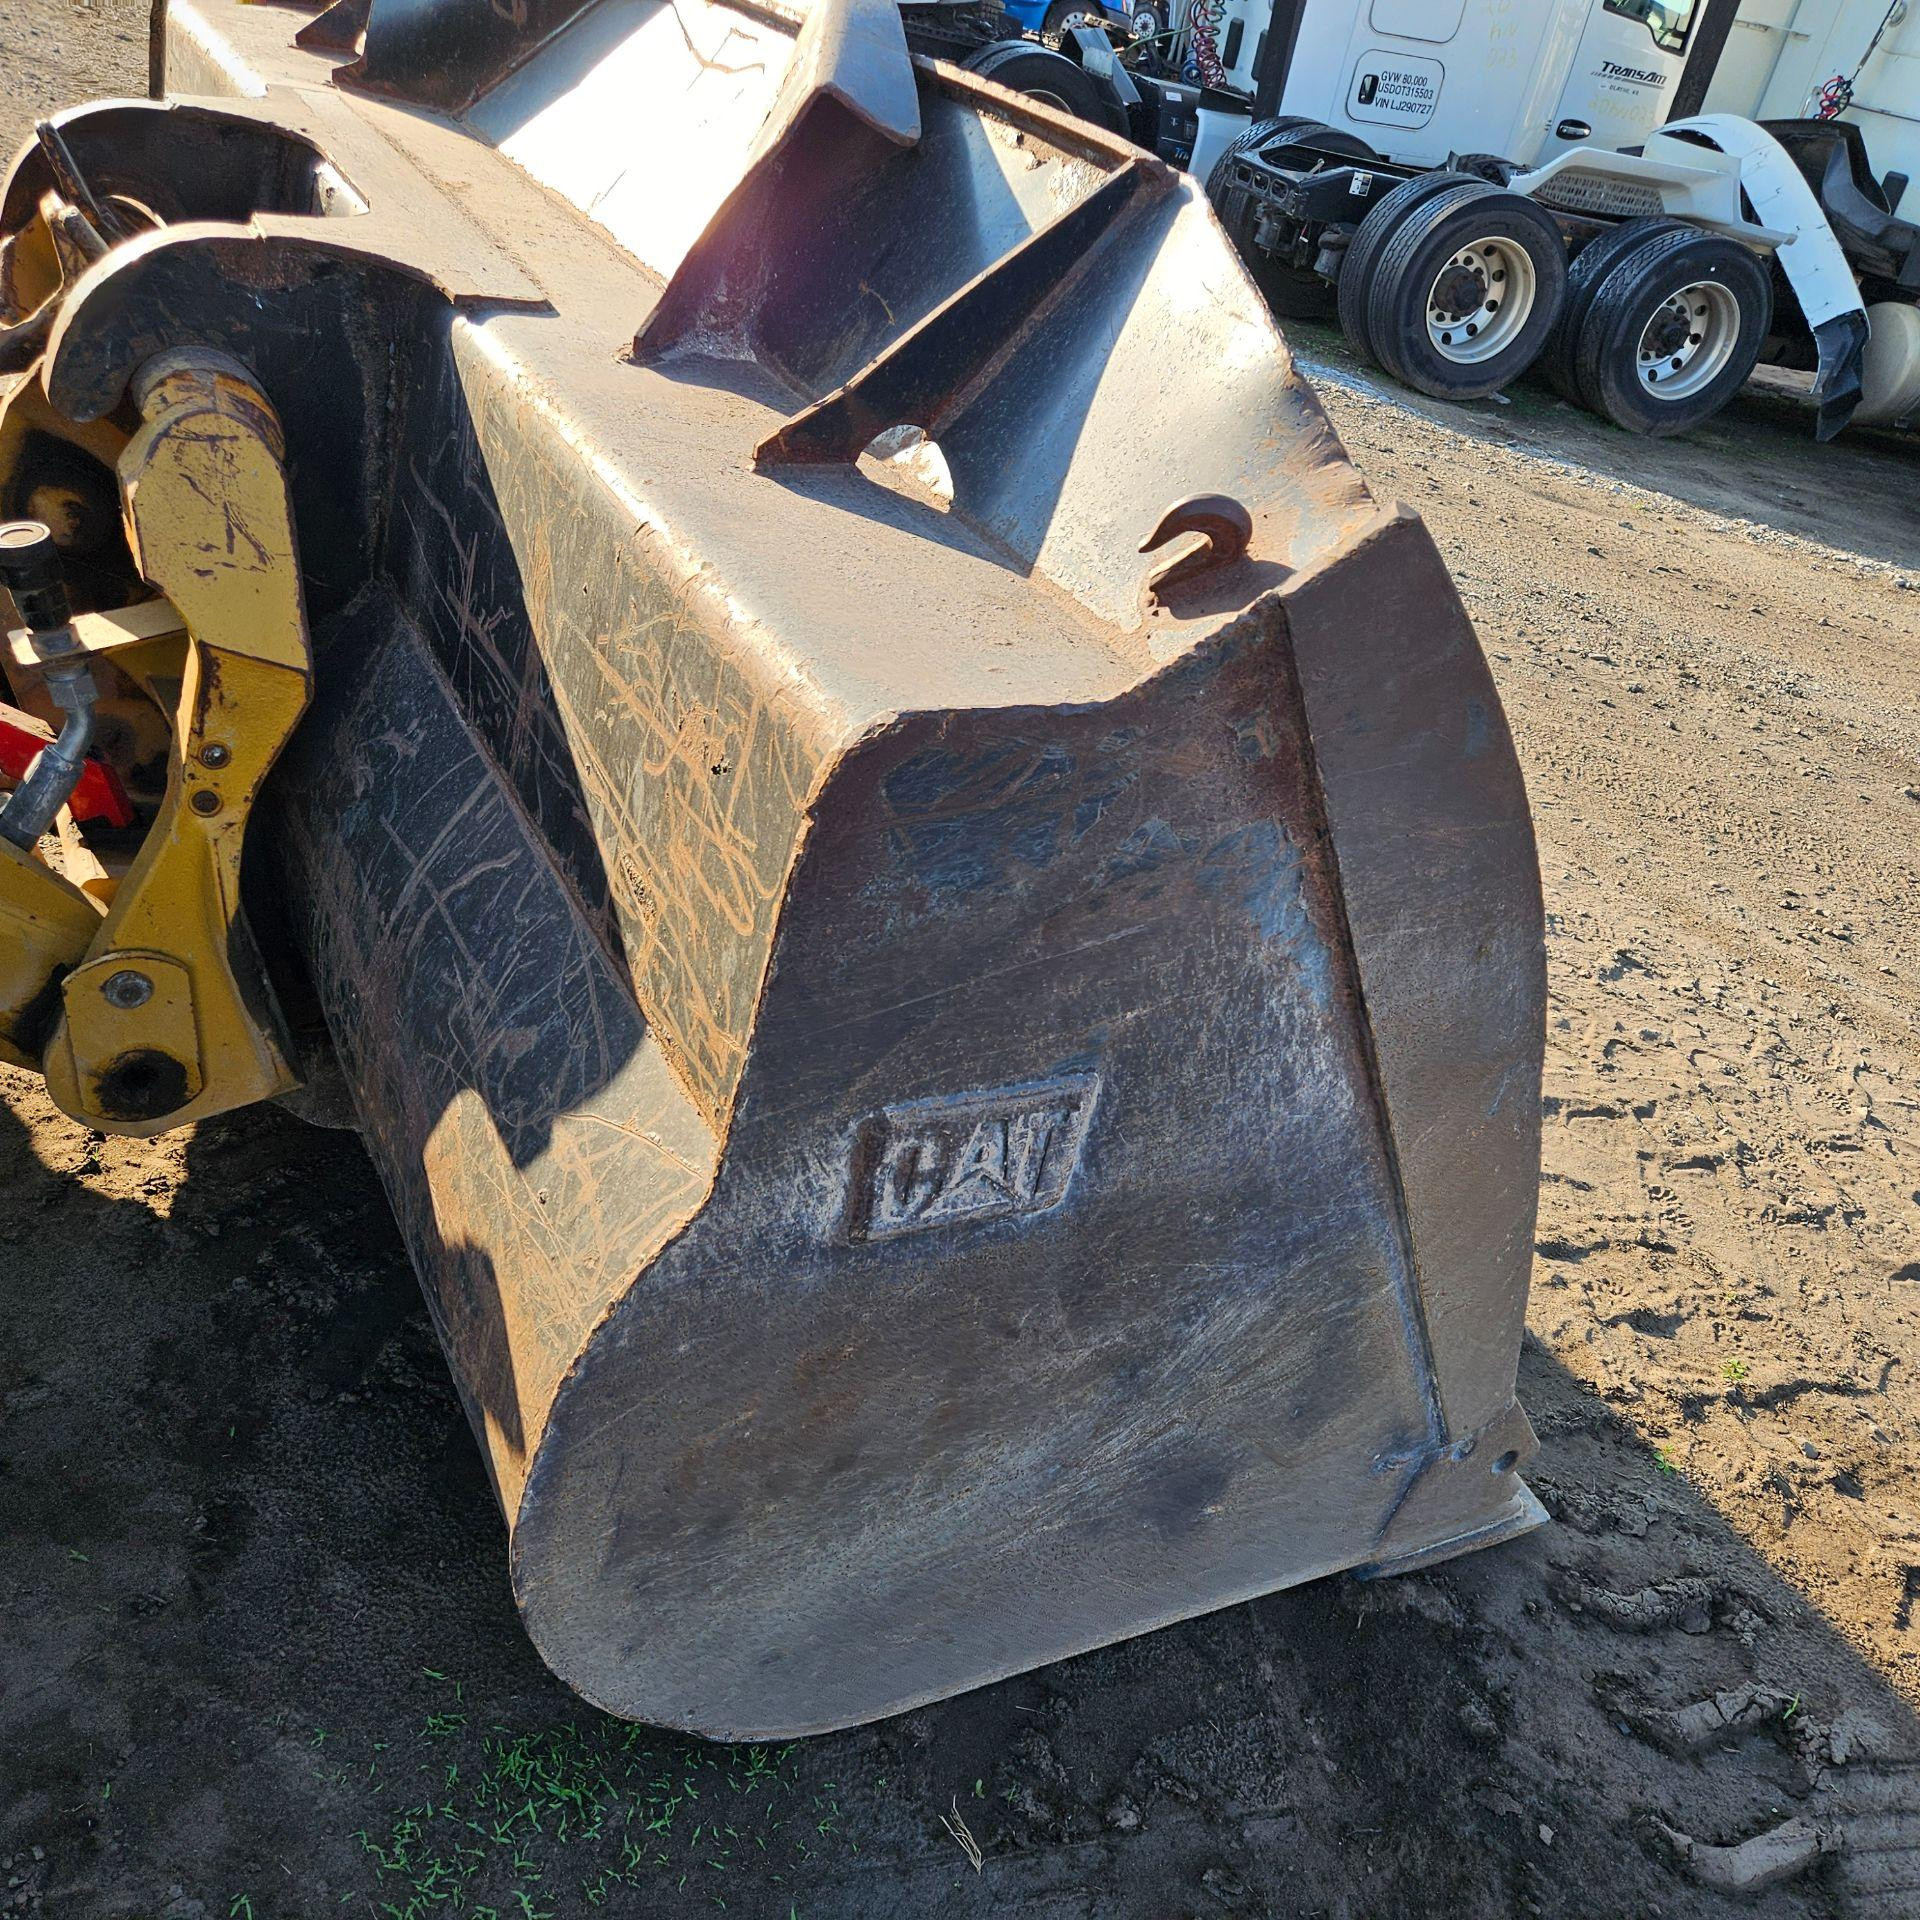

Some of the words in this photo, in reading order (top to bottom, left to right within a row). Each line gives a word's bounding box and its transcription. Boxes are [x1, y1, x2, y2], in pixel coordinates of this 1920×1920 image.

[1381, 71, 1402, 83] GVW
[1378, 82, 1434, 100] USDOT315503
[1375, 97, 1390, 108] VIN
[1390, 100, 1432, 114] LJ290727
[879, 1107, 1074, 1226] CAT
